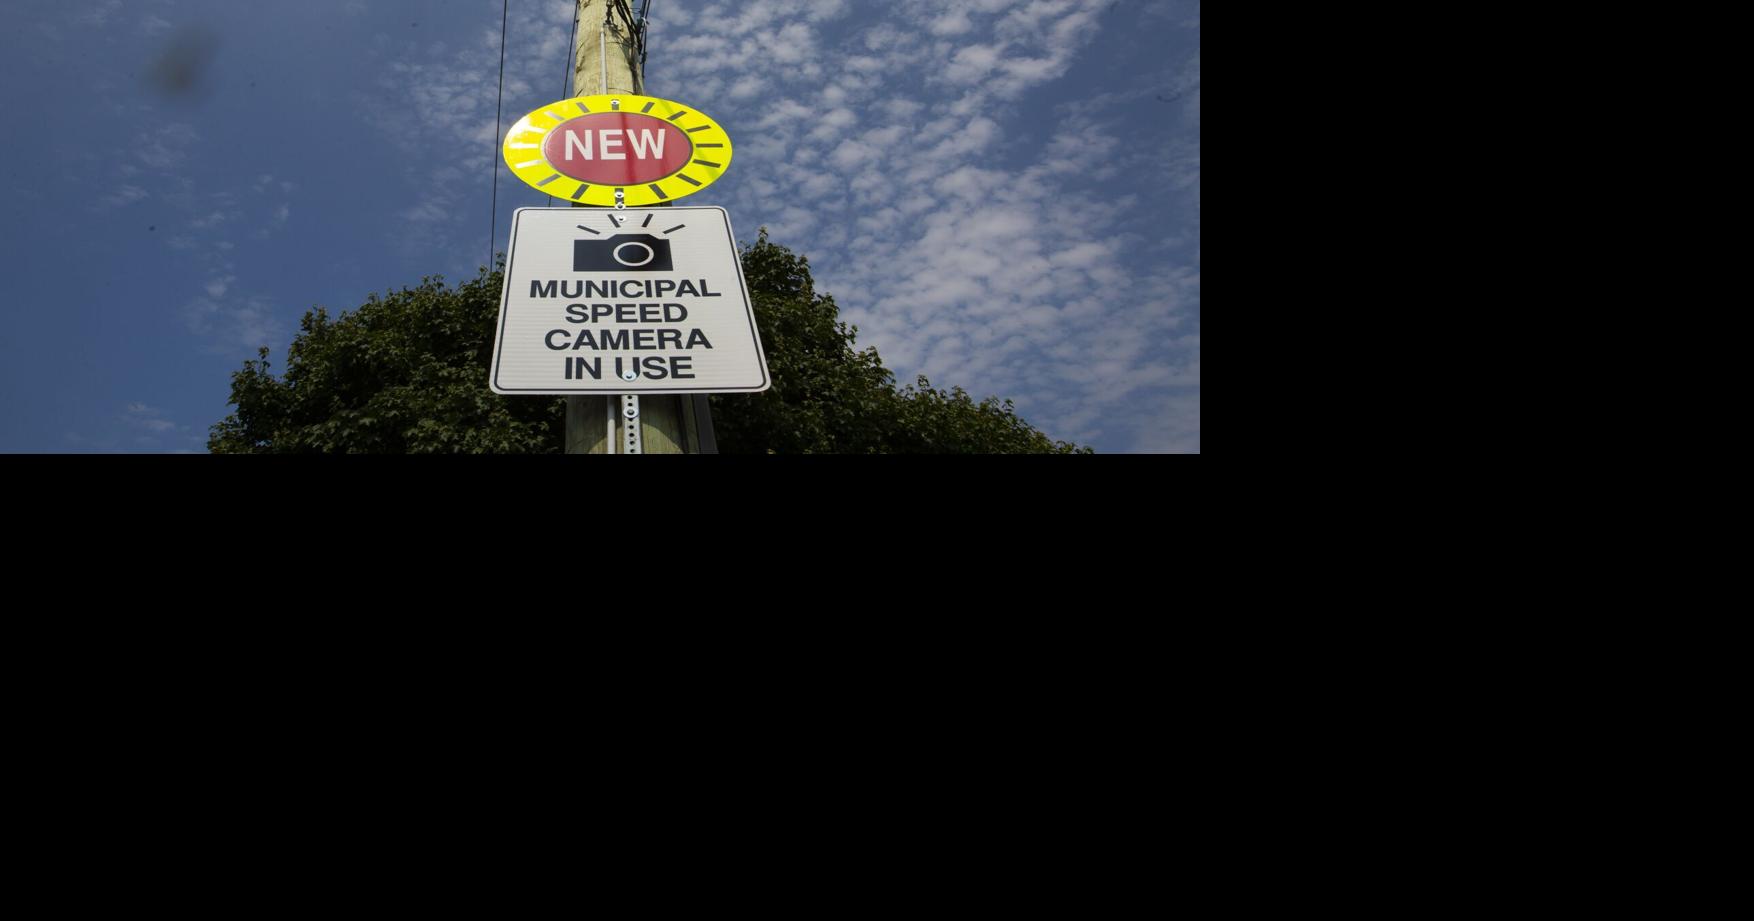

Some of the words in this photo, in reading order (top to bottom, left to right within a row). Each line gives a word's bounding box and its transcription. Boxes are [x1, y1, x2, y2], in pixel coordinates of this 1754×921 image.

[564, 128, 666, 161] NEW
[529, 279, 722, 298] MUNICIPAL
[565, 303, 688, 323] SPEED
[544, 328, 713, 350] CAMERA
[564, 357, 602, 380] IN
[615, 356, 695, 380] USE
